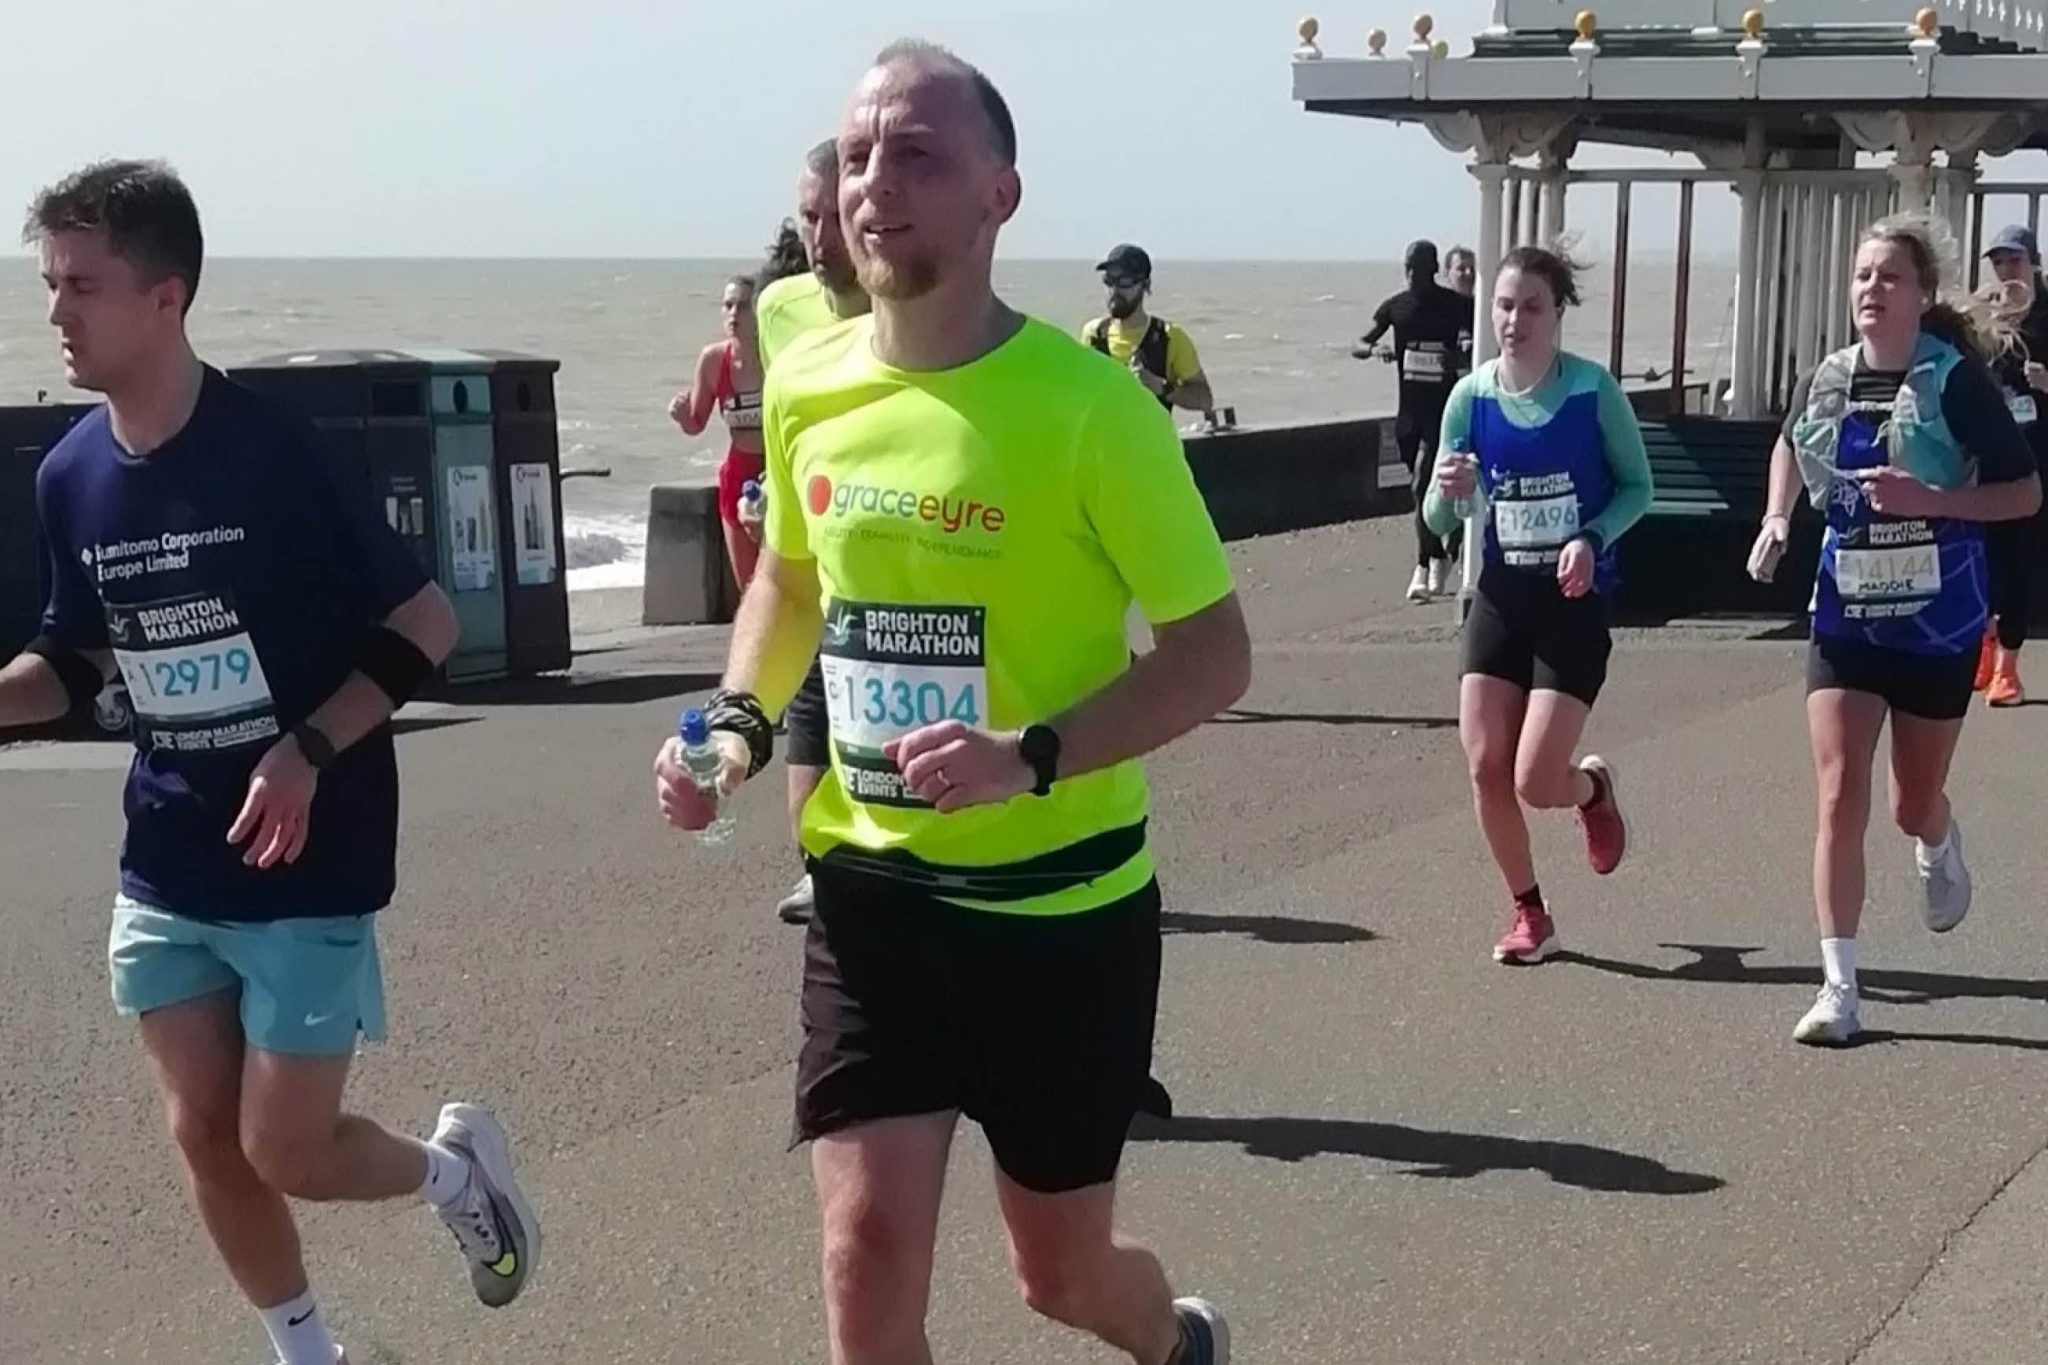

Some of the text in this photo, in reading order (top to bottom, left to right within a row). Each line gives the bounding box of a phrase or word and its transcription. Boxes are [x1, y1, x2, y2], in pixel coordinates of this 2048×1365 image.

[834, 483, 1005, 533] graceeyre
[1511, 505, 1575, 531] 12496
[161, 525, 244, 551] Corporation
[1869, 519, 1926, 533] BRIGHTON
[1869, 530, 1933, 544] MARATHON
[147, 550, 189, 573] Limited
[1855, 553, 1935, 581] 14144
[138, 597, 224, 627] BRIGHTON
[865, 610, 968, 634] BRIGHTON
[144, 610, 239, 642] MARATHON
[866, 631, 980, 656] MARATHON
[139, 648, 251, 697] 12979
[845, 675, 980, 727] 13304
[857, 768, 904, 786] LONDON
